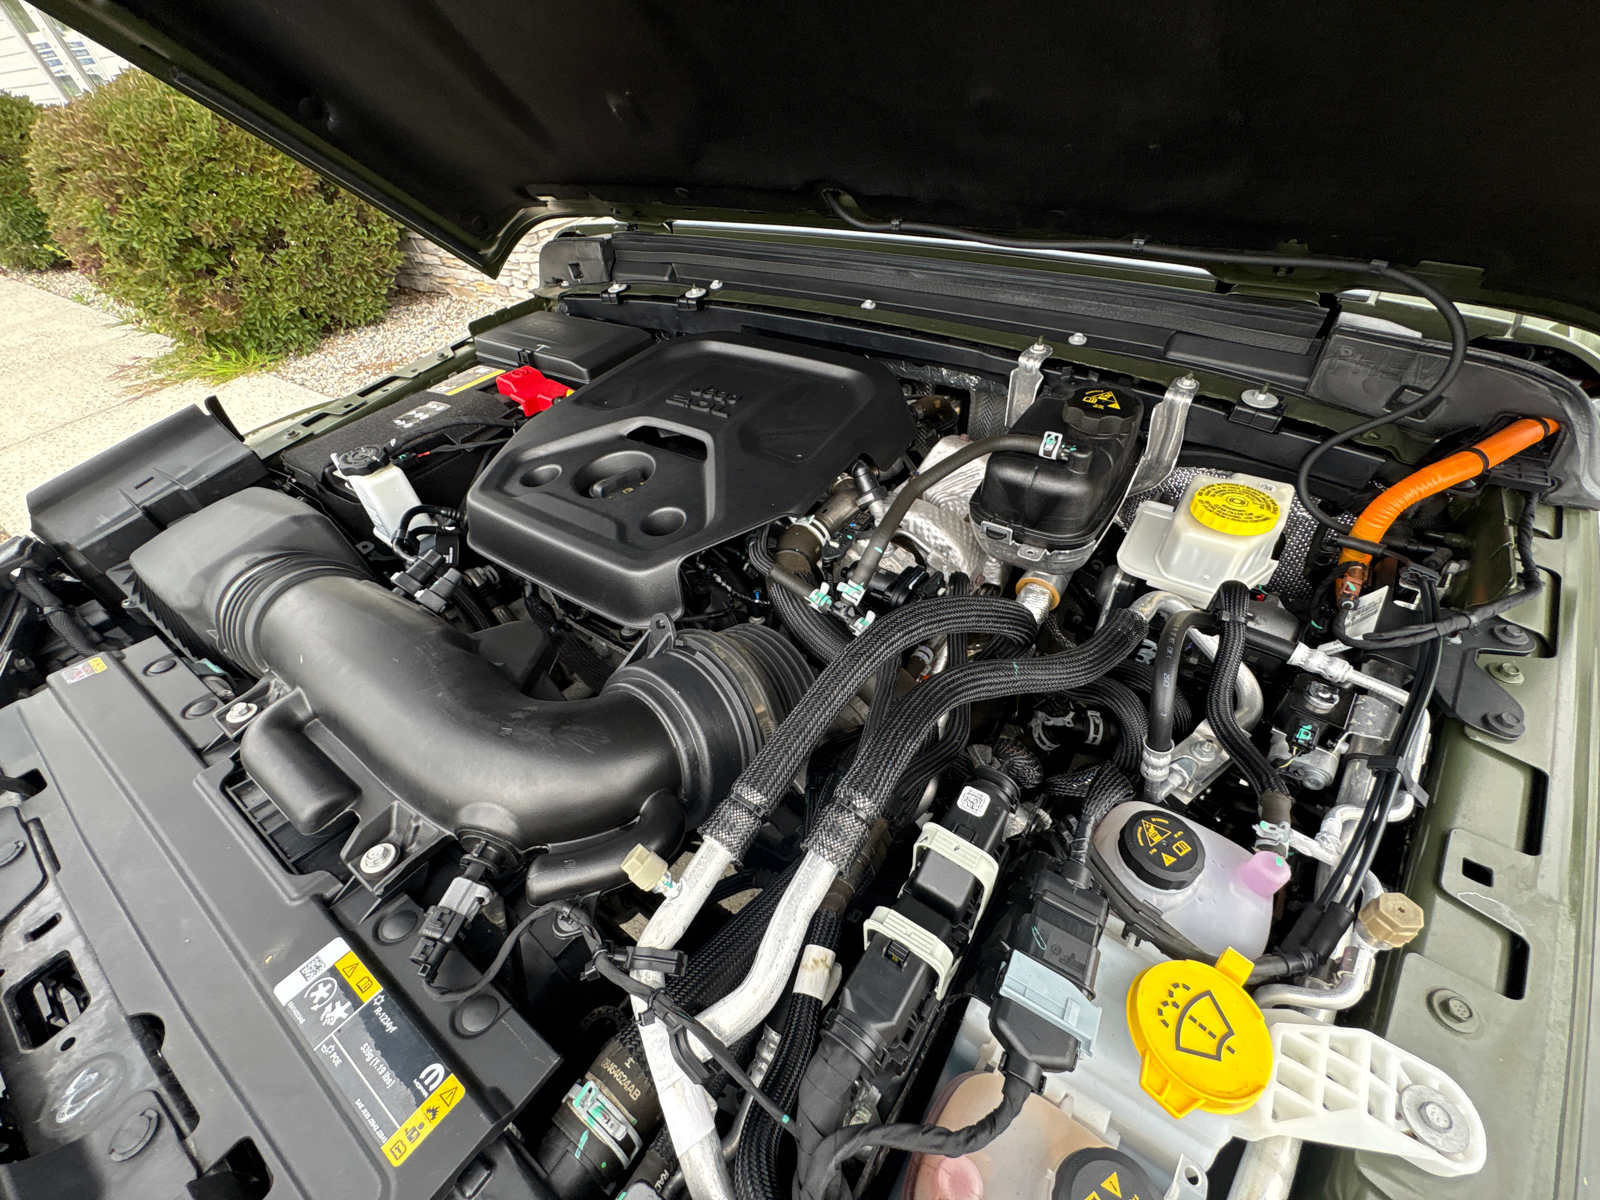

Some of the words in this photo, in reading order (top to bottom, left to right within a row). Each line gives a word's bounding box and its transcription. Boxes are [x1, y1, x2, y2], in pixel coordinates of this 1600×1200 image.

[1328, 345, 1446, 385] PHEV
[373, 1006, 397, 1034] R-1234yf
[329, 1052, 343, 1067] POE
[360, 1043, 375, 1062] 539g
[369, 1057, 386, 1075] (1.19
[379, 1071, 396, 1089] lbs)
